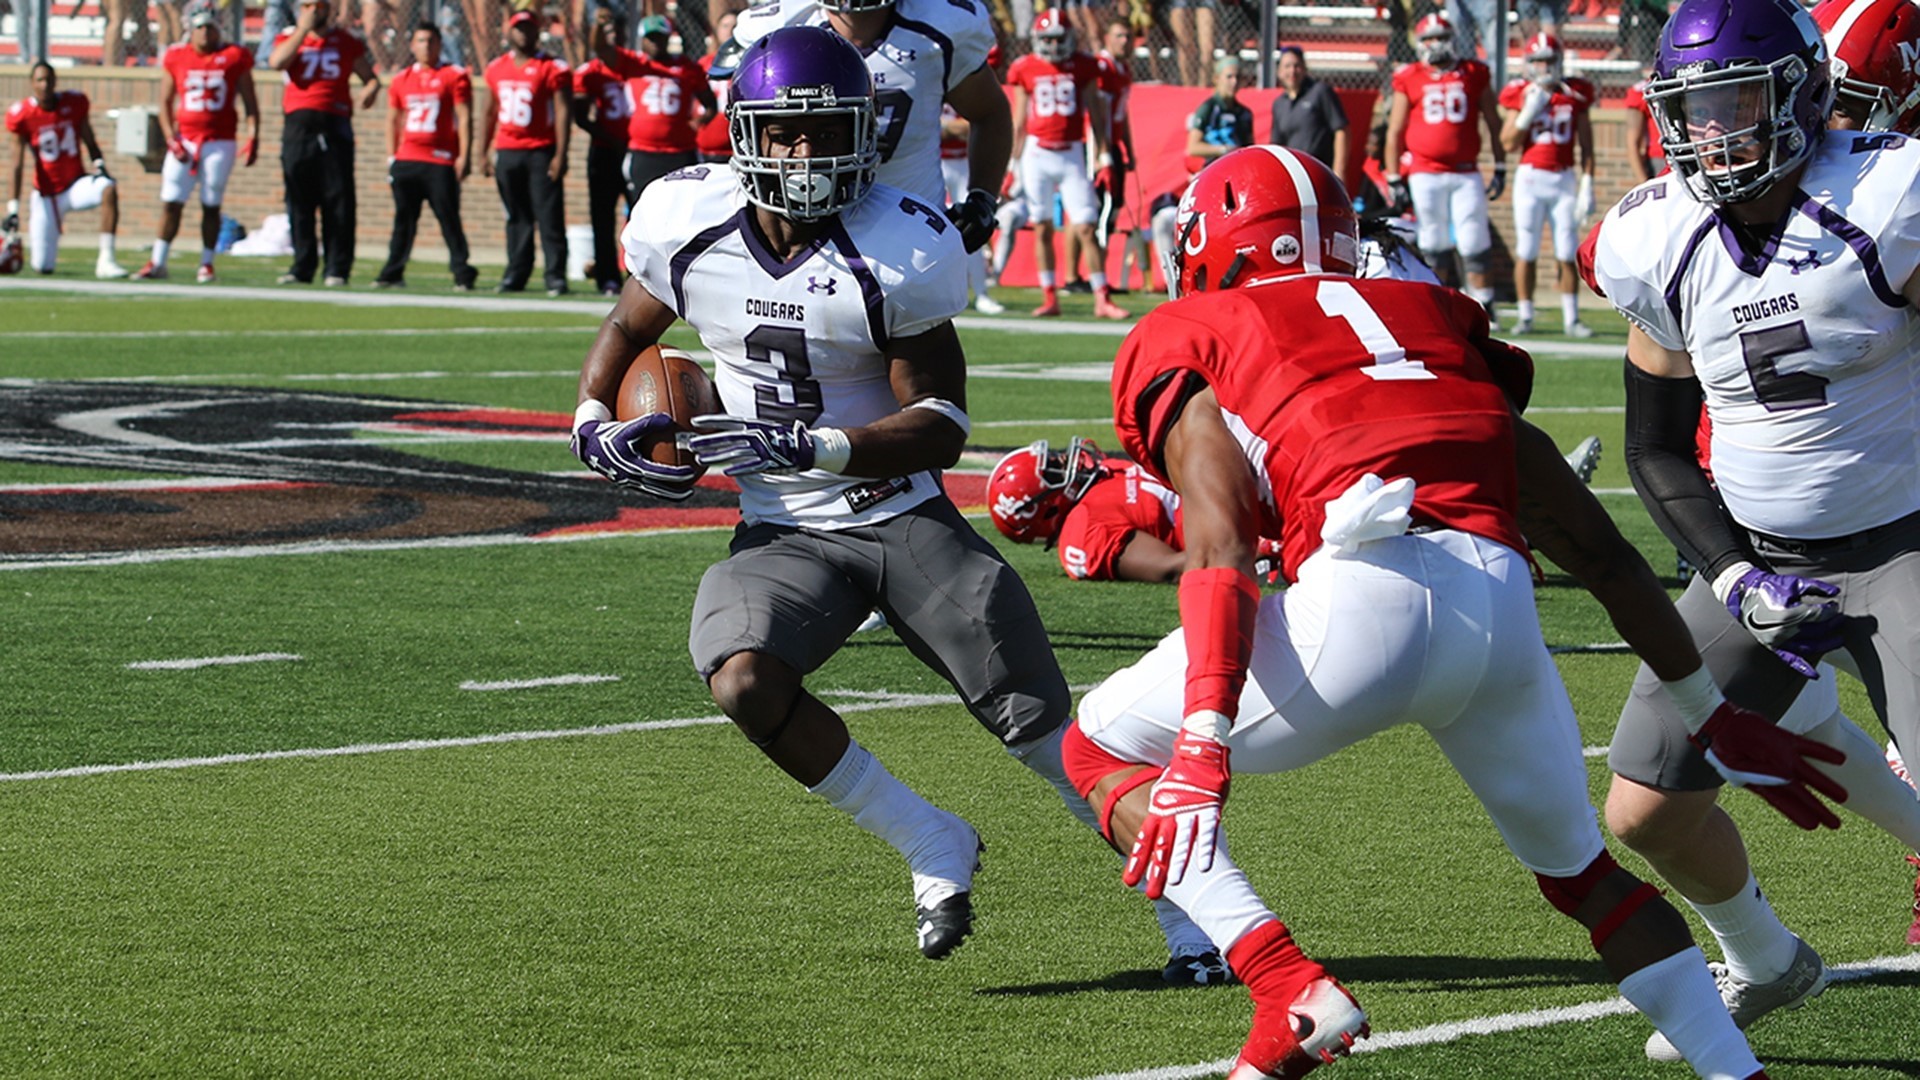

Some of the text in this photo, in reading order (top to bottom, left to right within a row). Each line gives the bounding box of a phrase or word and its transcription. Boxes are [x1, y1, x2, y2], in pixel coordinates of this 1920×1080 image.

[302, 50, 341, 79] 75
[183, 77, 228, 111] 23
[641, 78, 681, 115] 46
[790, 87, 820, 97] FAMILY
[1034, 79, 1077, 117] 89
[1422, 91, 1468, 124] 60
[405, 101, 440, 133] 27
[745, 298, 805, 322] COUGARS
[1732, 292, 1800, 324] COUGARS
[1316, 279, 1438, 381] 1
[744, 324, 824, 429] 3
[1739, 319, 1831, 413] 5
